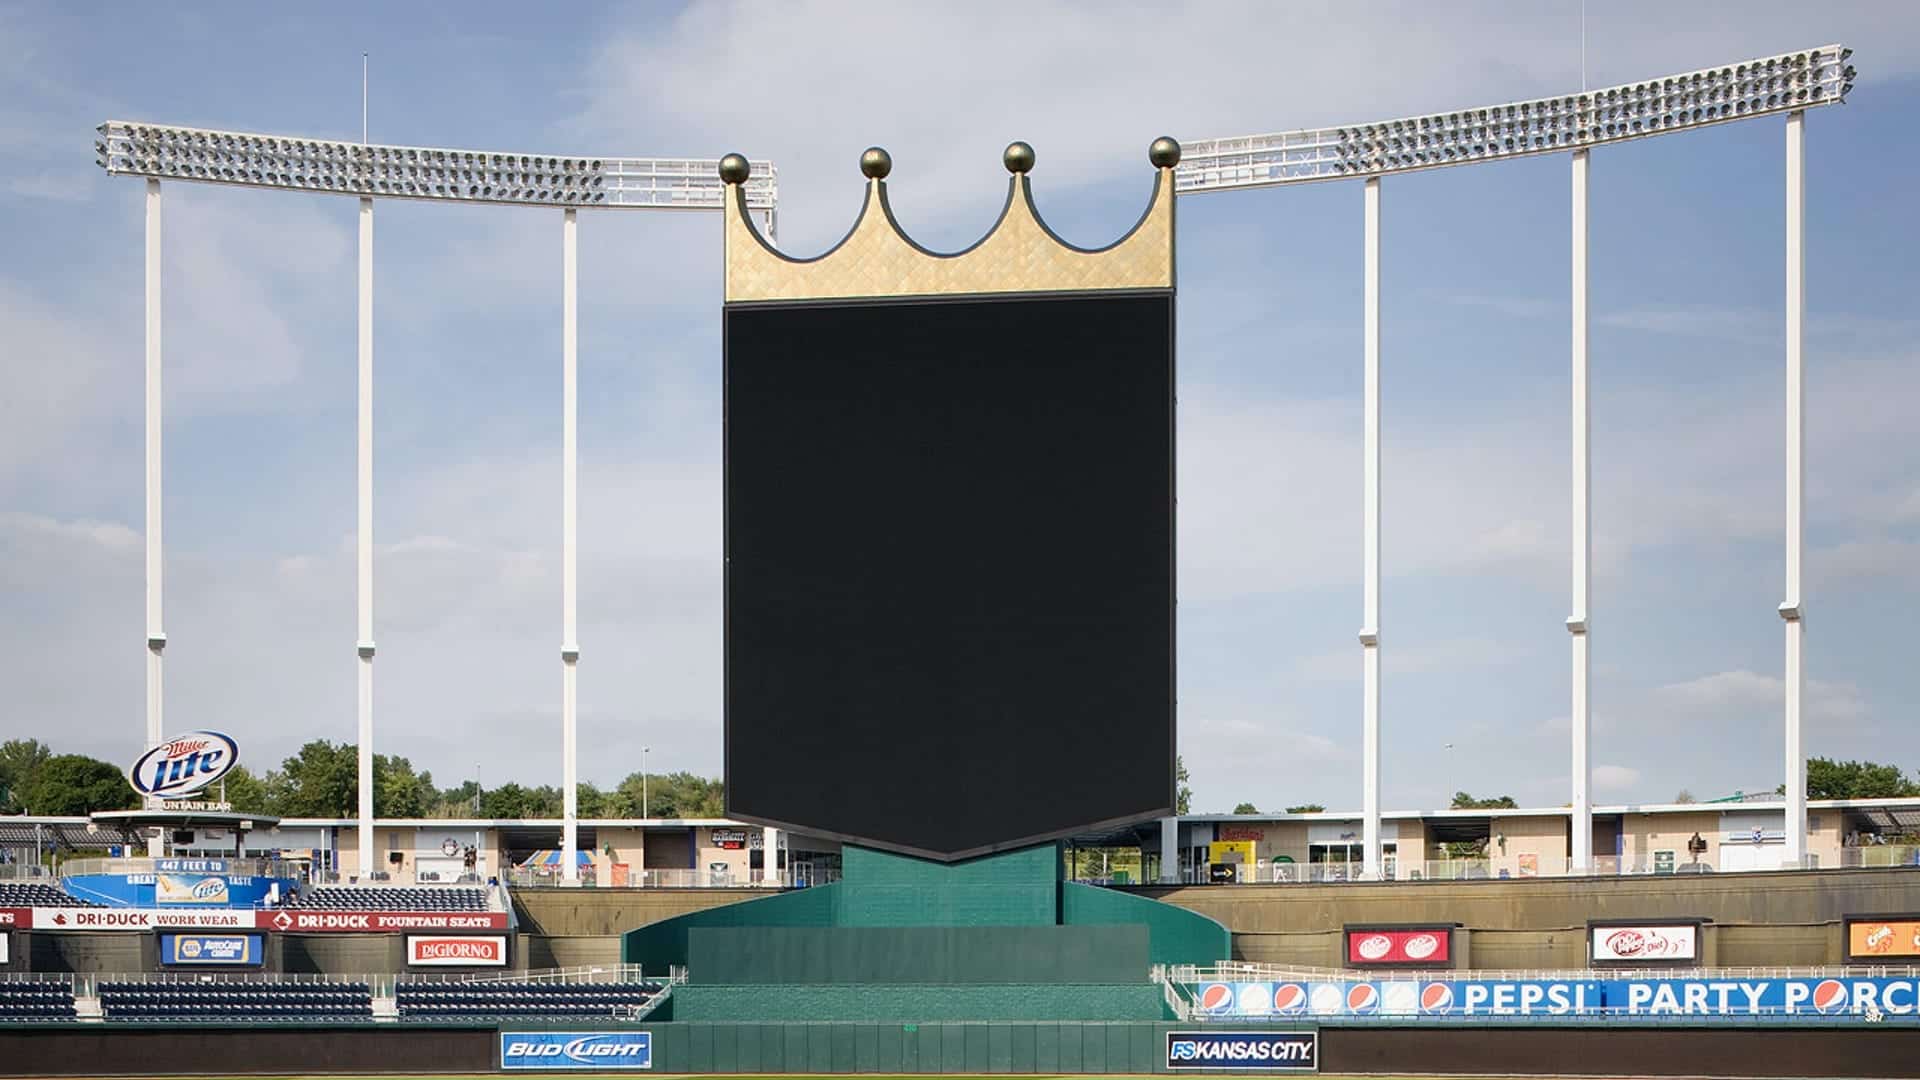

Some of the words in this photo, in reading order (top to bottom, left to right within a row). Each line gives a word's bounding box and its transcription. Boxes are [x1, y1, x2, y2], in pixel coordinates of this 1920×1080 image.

[161, 740, 209, 759] Miller
[152, 749, 223, 793] Lite
[208, 802, 231, 811] BAR
[161, 861, 178, 870] 447
[183, 861, 206, 870] FEET
[210, 862, 222, 871] TO
[127, 875, 156, 885] GREAT
[228, 876, 252, 886] TASTE
[157, 916, 196, 925] WORK
[200, 916, 239, 926] WEAR
[378, 917, 447, 928] FOUNTAIN
[449, 917, 492, 928] SEATS
[1464, 984, 1585, 1015] PEPSI
[1628, 982, 1770, 1015] PARTY
[506, 1042, 563, 1056] BUD
[574, 1043, 647, 1056] LIGHT
